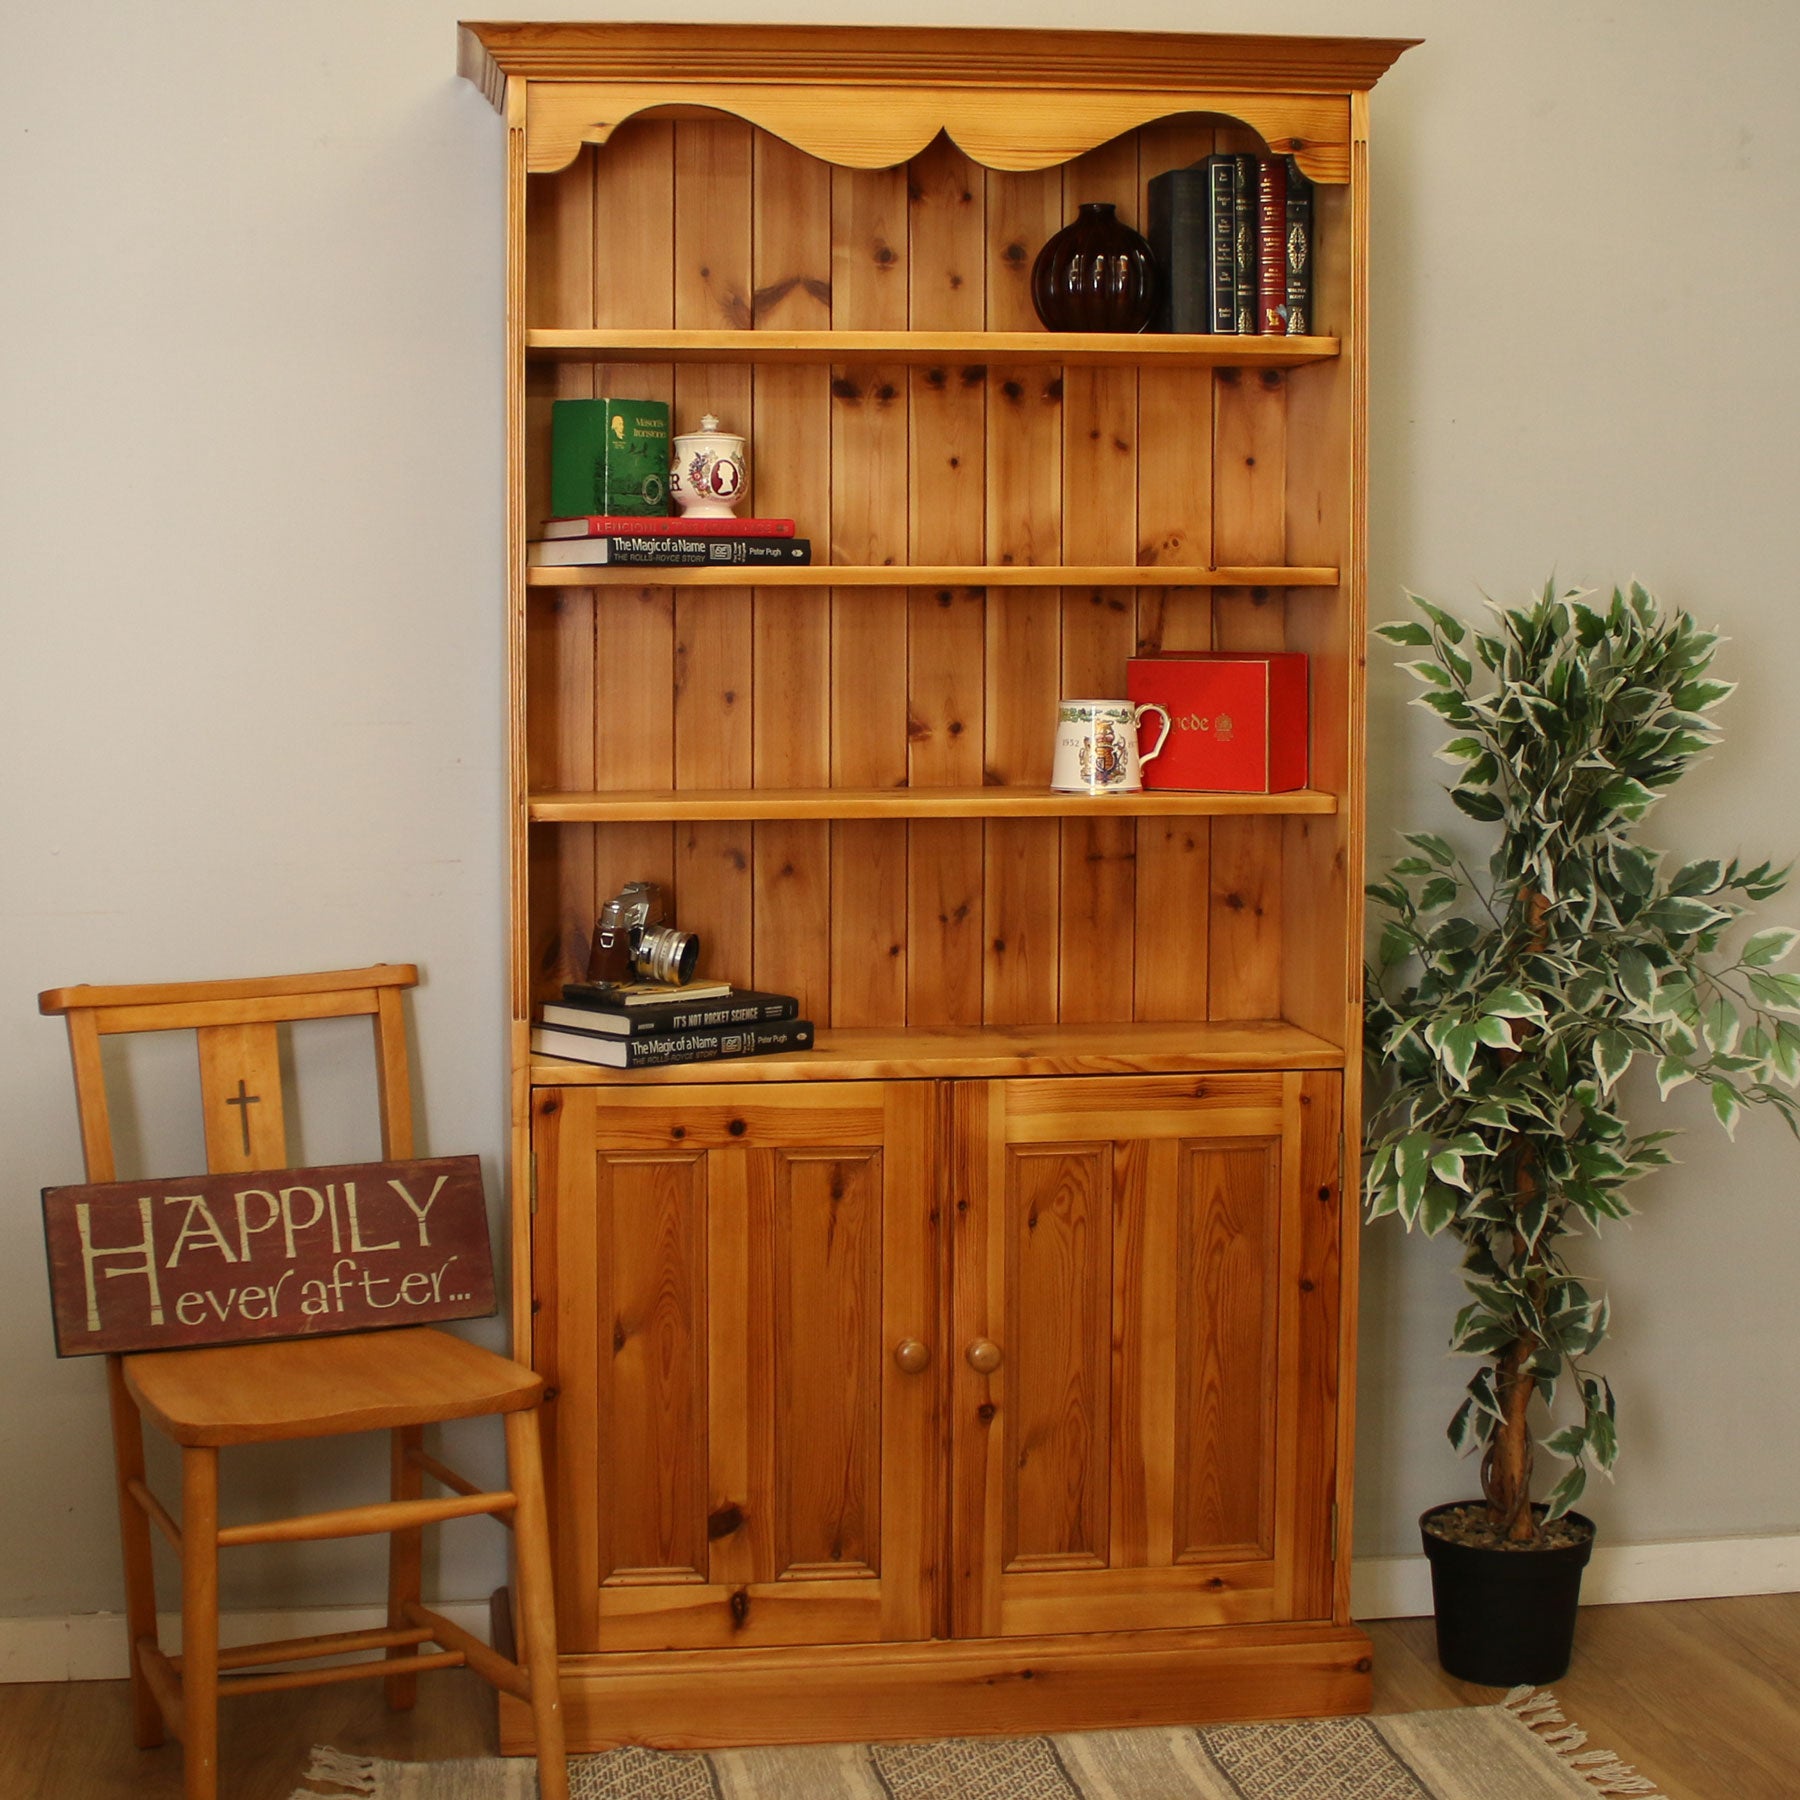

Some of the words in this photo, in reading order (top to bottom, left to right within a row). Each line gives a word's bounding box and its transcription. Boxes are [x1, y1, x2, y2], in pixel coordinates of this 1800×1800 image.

[613, 537, 632, 551] The
[632, 538, 661, 555] Magic
[661, 538, 671, 552] of
[672, 542, 678, 552] a
[678, 539, 706, 552] Name
[749, 547, 765, 556] Peter
[765, 548, 781, 557] Pugh
[613, 553, 629, 561] THE
[629, 553, 680, 563] ROLLS-ROYCE
[682, 554, 706, 563] STORY
[1062, 738, 1080, 748] 1952
[673, 1015, 687, 1029] IT'S
[688, 1012, 702, 1027] NOT
[703, 1010, 730, 1025] ROCKET
[730, 1007, 759, 1022] SCIENCE
[631, 1041, 649, 1056] The
[648, 1038, 677, 1056] Magic
[676, 1036, 686, 1051] of
[686, 1040, 692, 1051] a
[691, 1036, 718, 1049] Name
[757, 1036, 773, 1044] Peter
[772, 1034, 788, 1045] Pugh
[75, 1175, 449, 1332] HAPPILY
[175, 1269, 294, 1326] ever
